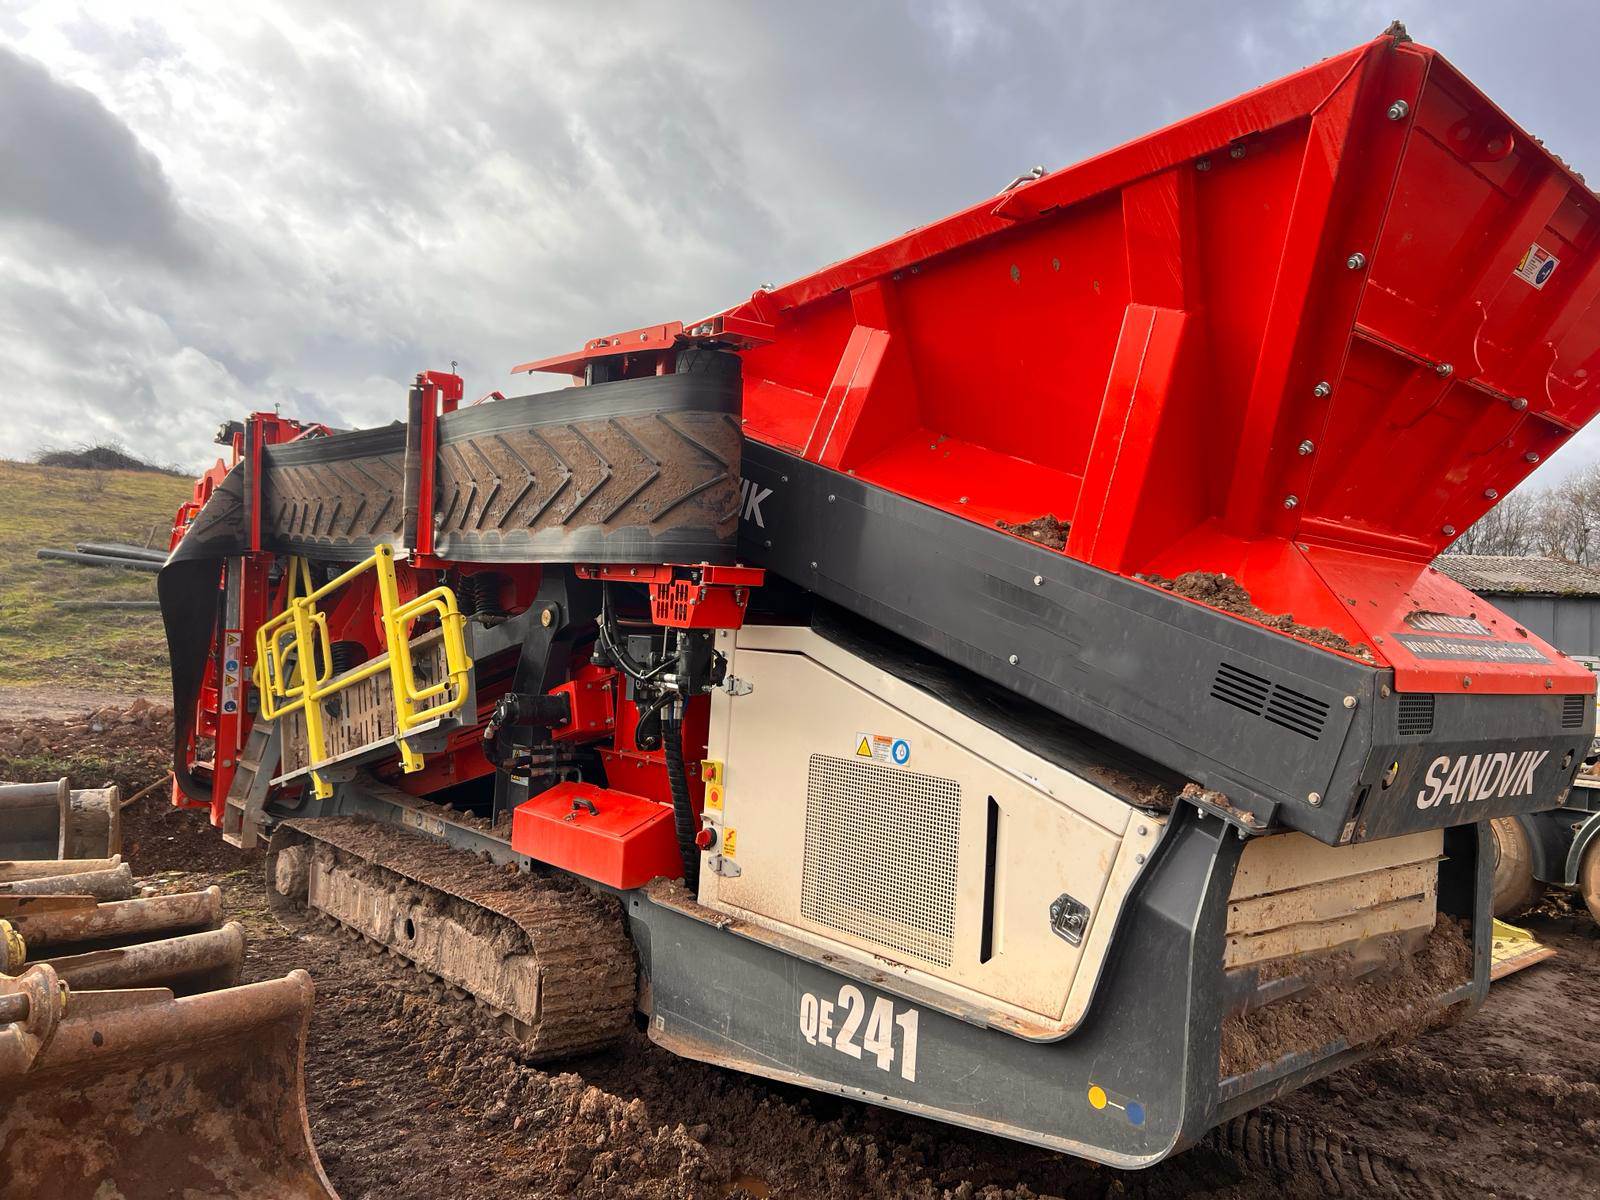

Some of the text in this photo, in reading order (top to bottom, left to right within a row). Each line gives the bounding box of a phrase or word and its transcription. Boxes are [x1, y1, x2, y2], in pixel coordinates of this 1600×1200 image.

[739, 477, 774, 528] IK
[1416, 750, 1550, 809] SANDVIK
[800, 984, 919, 1083] QE241
